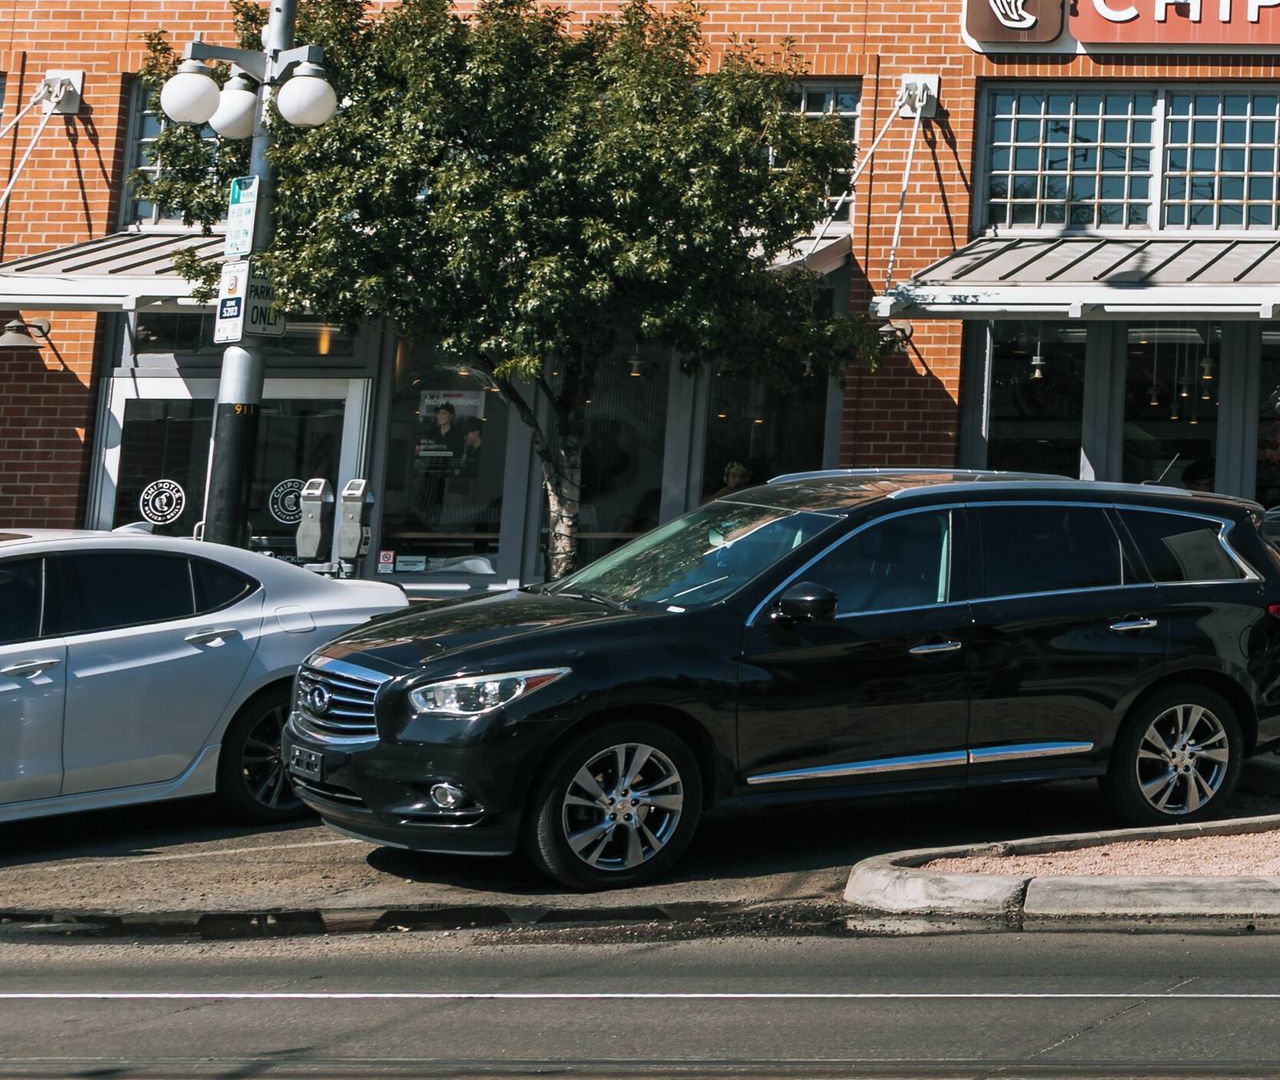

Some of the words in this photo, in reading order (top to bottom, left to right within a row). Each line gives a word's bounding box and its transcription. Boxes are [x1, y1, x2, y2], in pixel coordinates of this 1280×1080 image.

[250, 284, 276, 300] PARKI
[450, 398, 480, 406] HIRING
[234, 404, 254, 416] 911
[144, 482, 182, 500] CHIPOTLE
[274, 481, 304, 498] CHIPOT
[277, 555, 304, 563] PICKU
